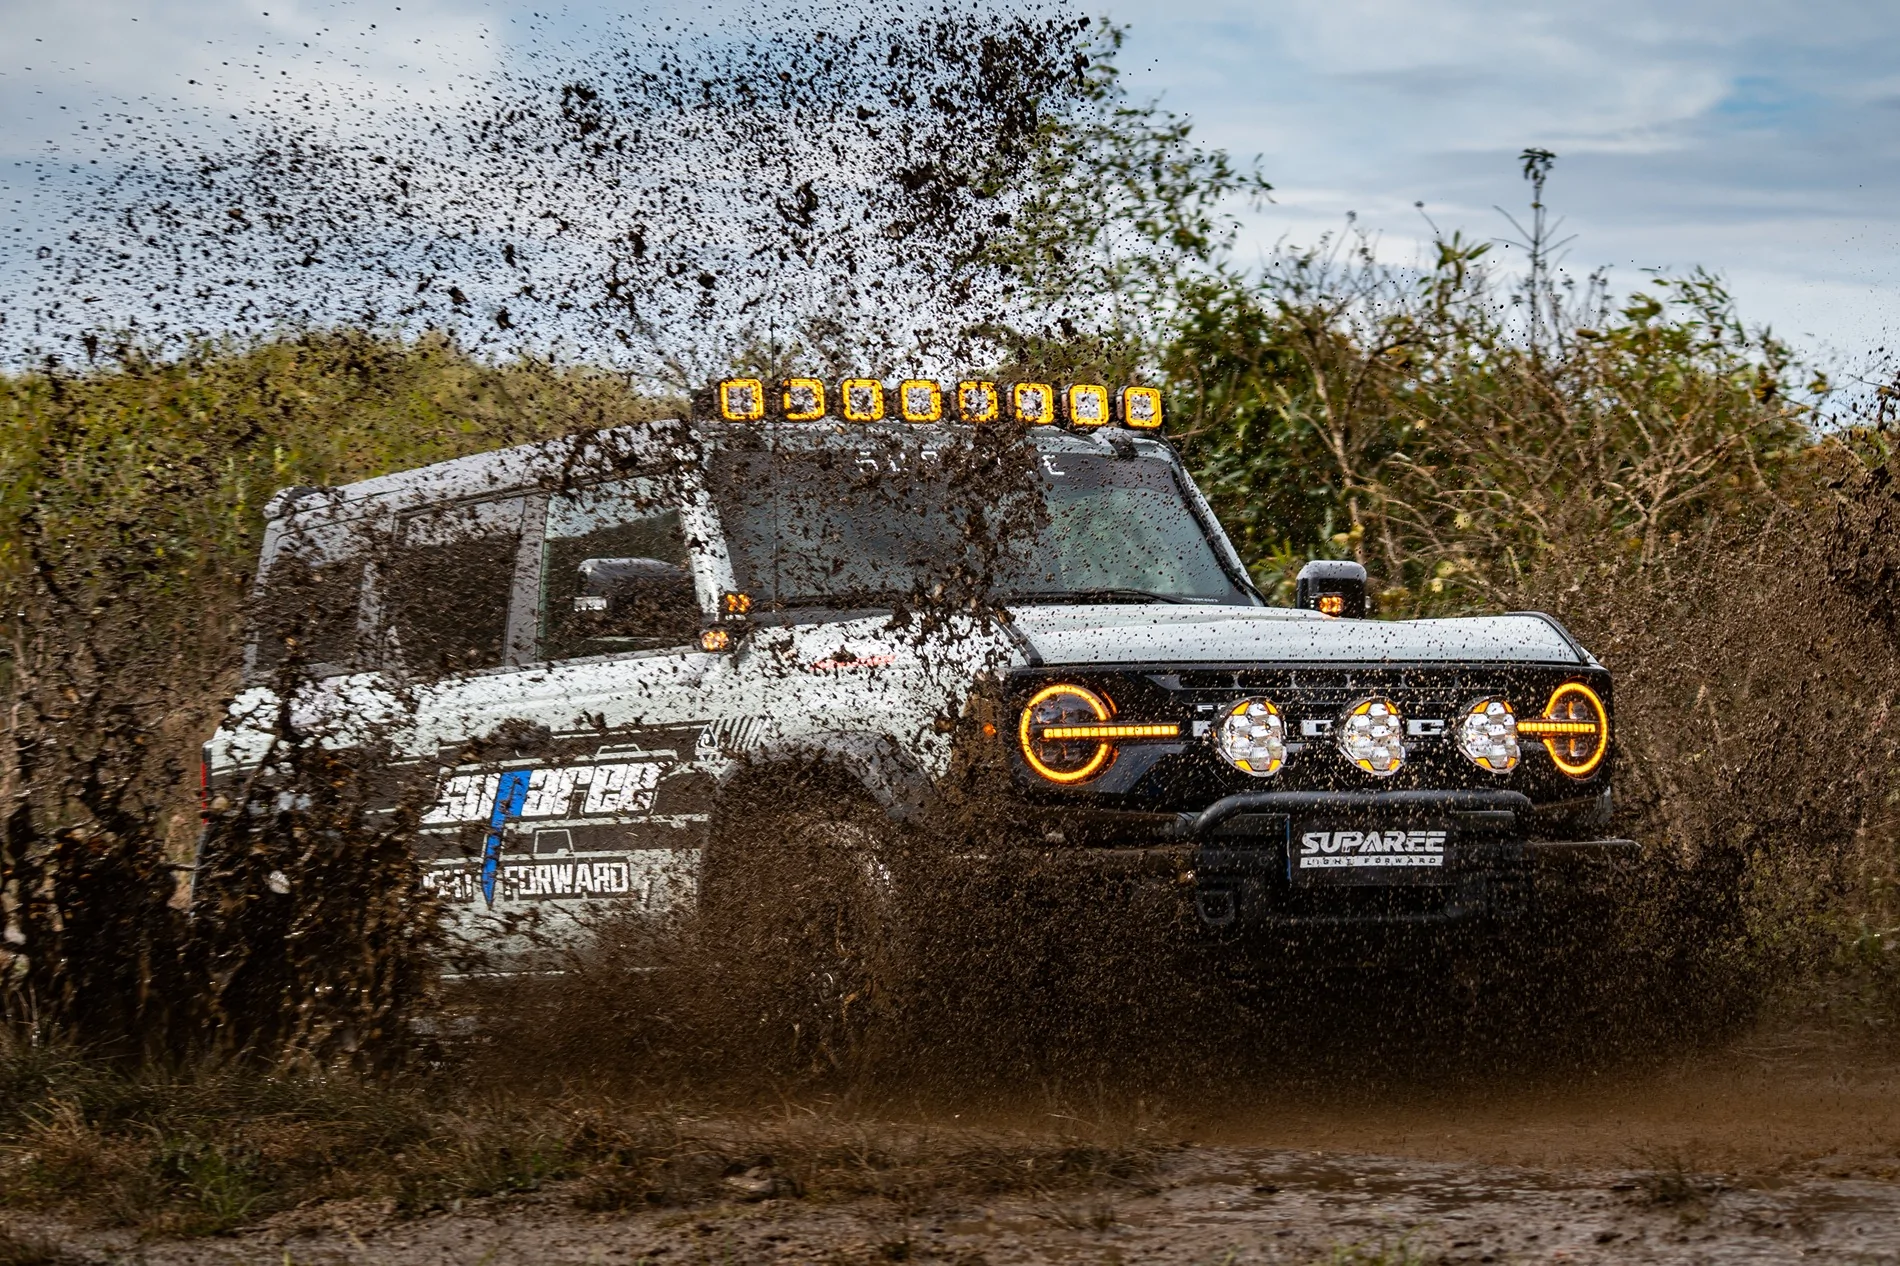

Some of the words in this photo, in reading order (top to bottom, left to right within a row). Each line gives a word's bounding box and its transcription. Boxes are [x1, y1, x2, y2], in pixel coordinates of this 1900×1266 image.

[1300, 830, 1447, 854] SUPAREE
[1363, 856, 1437, 866] FORWARD
[503, 862, 630, 895] FORWARD
